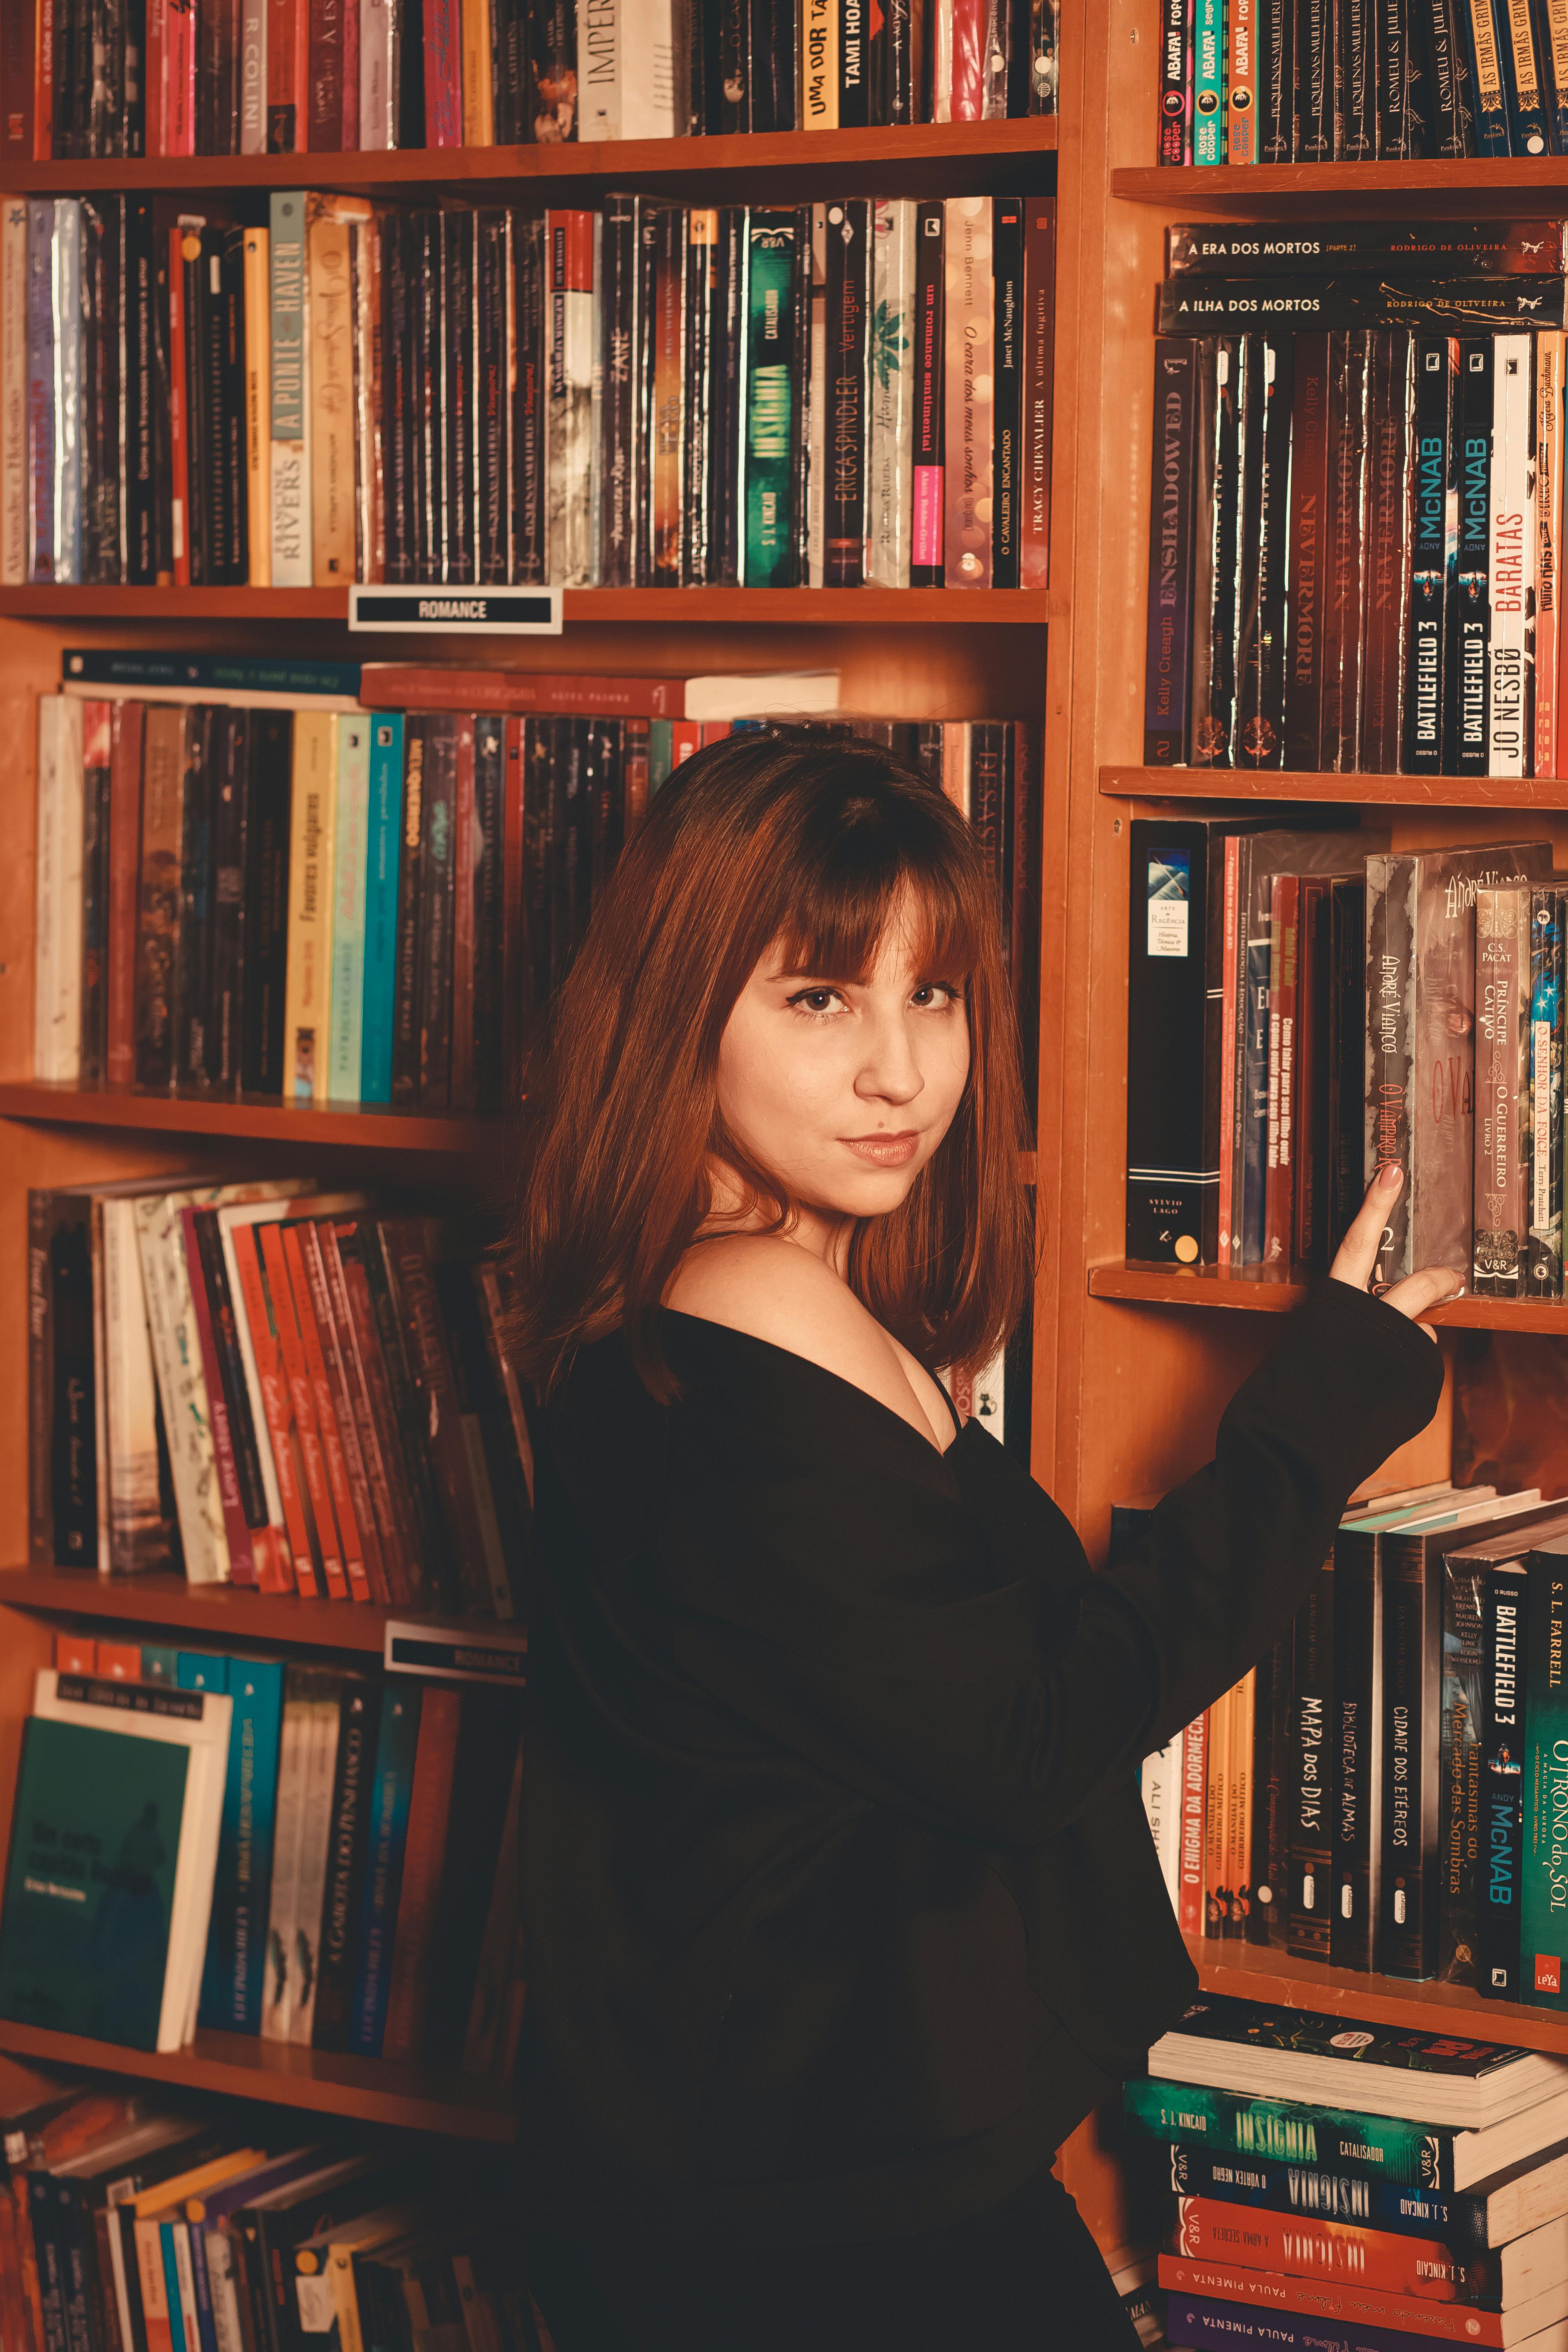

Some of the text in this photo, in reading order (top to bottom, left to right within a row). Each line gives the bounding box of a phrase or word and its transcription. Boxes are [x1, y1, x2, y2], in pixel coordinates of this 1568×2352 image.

[808, 27, 828, 115] UMA DOR
[845, 38, 861, 88] TAMI
[1167, 31, 1181, 81] ABAFA!
[1202, 30, 1215, 80] ABAFA!
[1235, 27, 1249, 76] ABAFA!
[1388, 40, 1400, 113] ROMEU &
[1436, 38, 1452, 112] ROMEU &
[1476, 31, 1497, 86] AS IRMÃS
[1514, 31, 1534, 85] AS IRMÃS
[245, 43, 260, 130] COLINI
[1271, 55, 1283, 118] PEQUENAS
[1311, 55, 1321, 116] PEQUENAS
[1352, 55, 1362, 115] PEQUENAS
[963, 220, 976, 306] Jenn Bennett
[1188, 242, 1320, 255] A ERA DOS MORTOS
[838, 280, 859, 352] Vertigem
[1003, 280, 1015, 369] Janet McNaughton
[1179, 299, 1320, 312] A ILHA DOS MORTOS
[274, 242, 301, 428] A PONTE HAVEN
[963, 326, 978, 377] O cara
[921, 284, 935, 451] um romance sentimental
[834, 375, 858, 501] ERICA SPINDLER
[1001, 429, 1012, 488] ENCANTADO
[1032, 399, 1044, 534] TRACY CHEVALIER
[280, 459, 301, 559] RIVERS
[1159, 392, 1182, 607] ENSHADOWED
[1419, 437, 1443, 538] McNAB
[1464, 438, 1487, 539] McNAB
[1001, 492, 1011, 543] CAVALEIRO
[1295, 494, 1316, 687] NEVERMORE
[1495, 513, 1523, 612] BARATAS
[419, 600, 487, 619] ROMANCE
[1157, 616, 1174, 716] Kelly Creagh
[1416, 621, 1438, 740] BATTLEFIELD 3
[1463, 622, 1484, 742] BATTLEFIELD 3
[1493, 648, 1521, 758] JO NESBØ
[1482, 952, 1512, 962] PACAT
[1487, 943, 1505, 952] C.S.
[1484, 984, 1495, 1040] CATIVO
[1496, 980, 1510, 1046] PRÍNCIPE
[1280, 1017, 1293, 1071] Como falar
[1536, 1026, 1548, 1157] O SENHOR DA FOICE
[1484, 1118, 1492, 1147] LIVRO
[1495, 1086, 1508, 1188] O GUERREIRO
[1535, 1164, 1547, 1223] Terry Pratchett
[1380, 1227, 1395, 1251] 2
[1485, 1260, 1507, 1270] V&R
[1549, 1582, 1563, 1688] S. L. FARRELL
[1494, 1605, 1516, 1724] BATTLEFIELD 3
[1300, 1697, 1322, 1831] MAPA DOS DIAS
[1341, 1702, 1357, 1842] BIBLIOTECA ALMAS
[1392, 1707, 1410, 1846] CIDADE DOS ETÉREOS
[1449, 1701, 1467, 1894] Mercado das Sombras
[1491, 1792, 1515, 1801] ANDY
[1184, 1795, 1202, 1884] O ENIGMA DA
[1215, 1813, 1224, 1870] GUERREIRO
[1237, 1812, 1246, 1869] GUERREIRO
[1467, 1838, 1479, 1859] do
[1489, 1805, 1512, 1905] McNAB
[1550, 1844, 1565, 1866] do
[1161, 2109, 1206, 2131] S. J. KINCAID
[1236, 2112, 1317, 2161] INSÍGNIA
[1178, 2154, 1188, 2180] V&R
[1213, 2166, 1260, 2189] VÓRTEX NEGRO
[1340, 2141, 1383, 2162] CATALISADOR
[1421, 2150, 1431, 2176] V&R
[1288, 2169, 1369, 2217] INSÍGNIA
[1401, 2199, 1448, 2222] S. J. KINCAID
[1188, 2214, 1200, 2244] V&R
[1213, 2226, 1262, 2247] ARMA SECRETA
[1192, 2272, 1286, 2298] PAULA PIMENTA
[1416, 2260, 1465, 2283] S. J. KINCAID
[1203, 2316, 1294, 2343] PAULA PIMENTA
[1295, 2291, 1456, 2332] Fazendo meu filme
